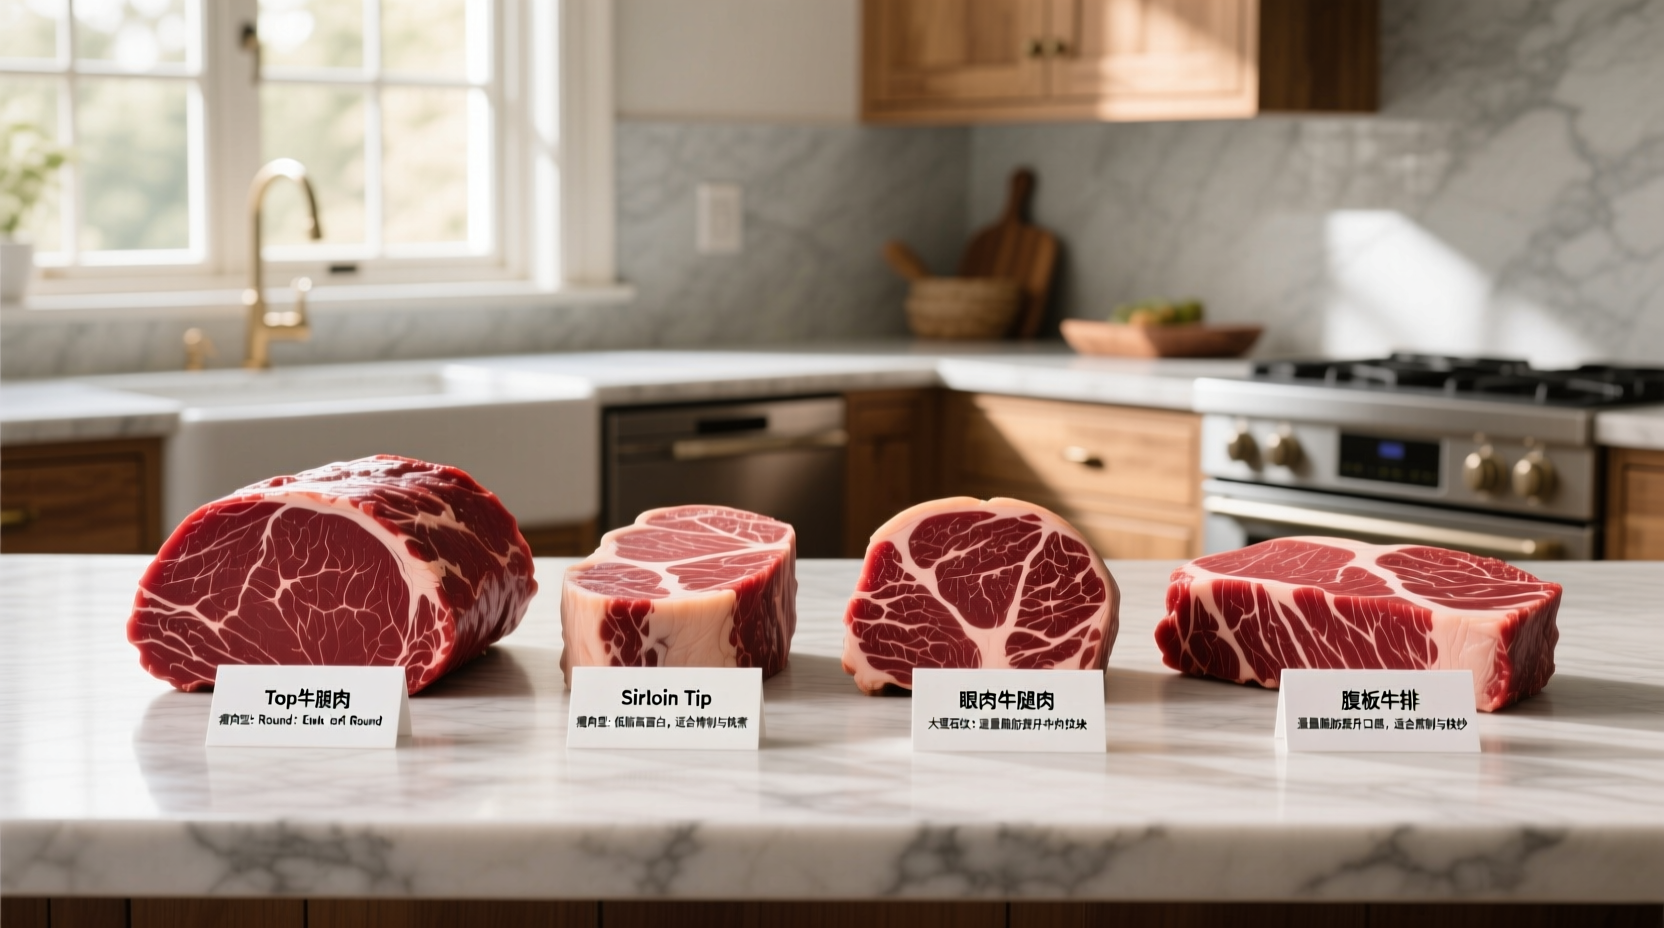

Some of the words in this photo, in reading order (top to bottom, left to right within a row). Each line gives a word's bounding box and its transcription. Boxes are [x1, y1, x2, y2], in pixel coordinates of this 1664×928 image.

[621, 688, 679, 707] Sirloin
[684, 688, 712, 710] Tip
[1341, 688, 1421, 711] 腹板牛排
